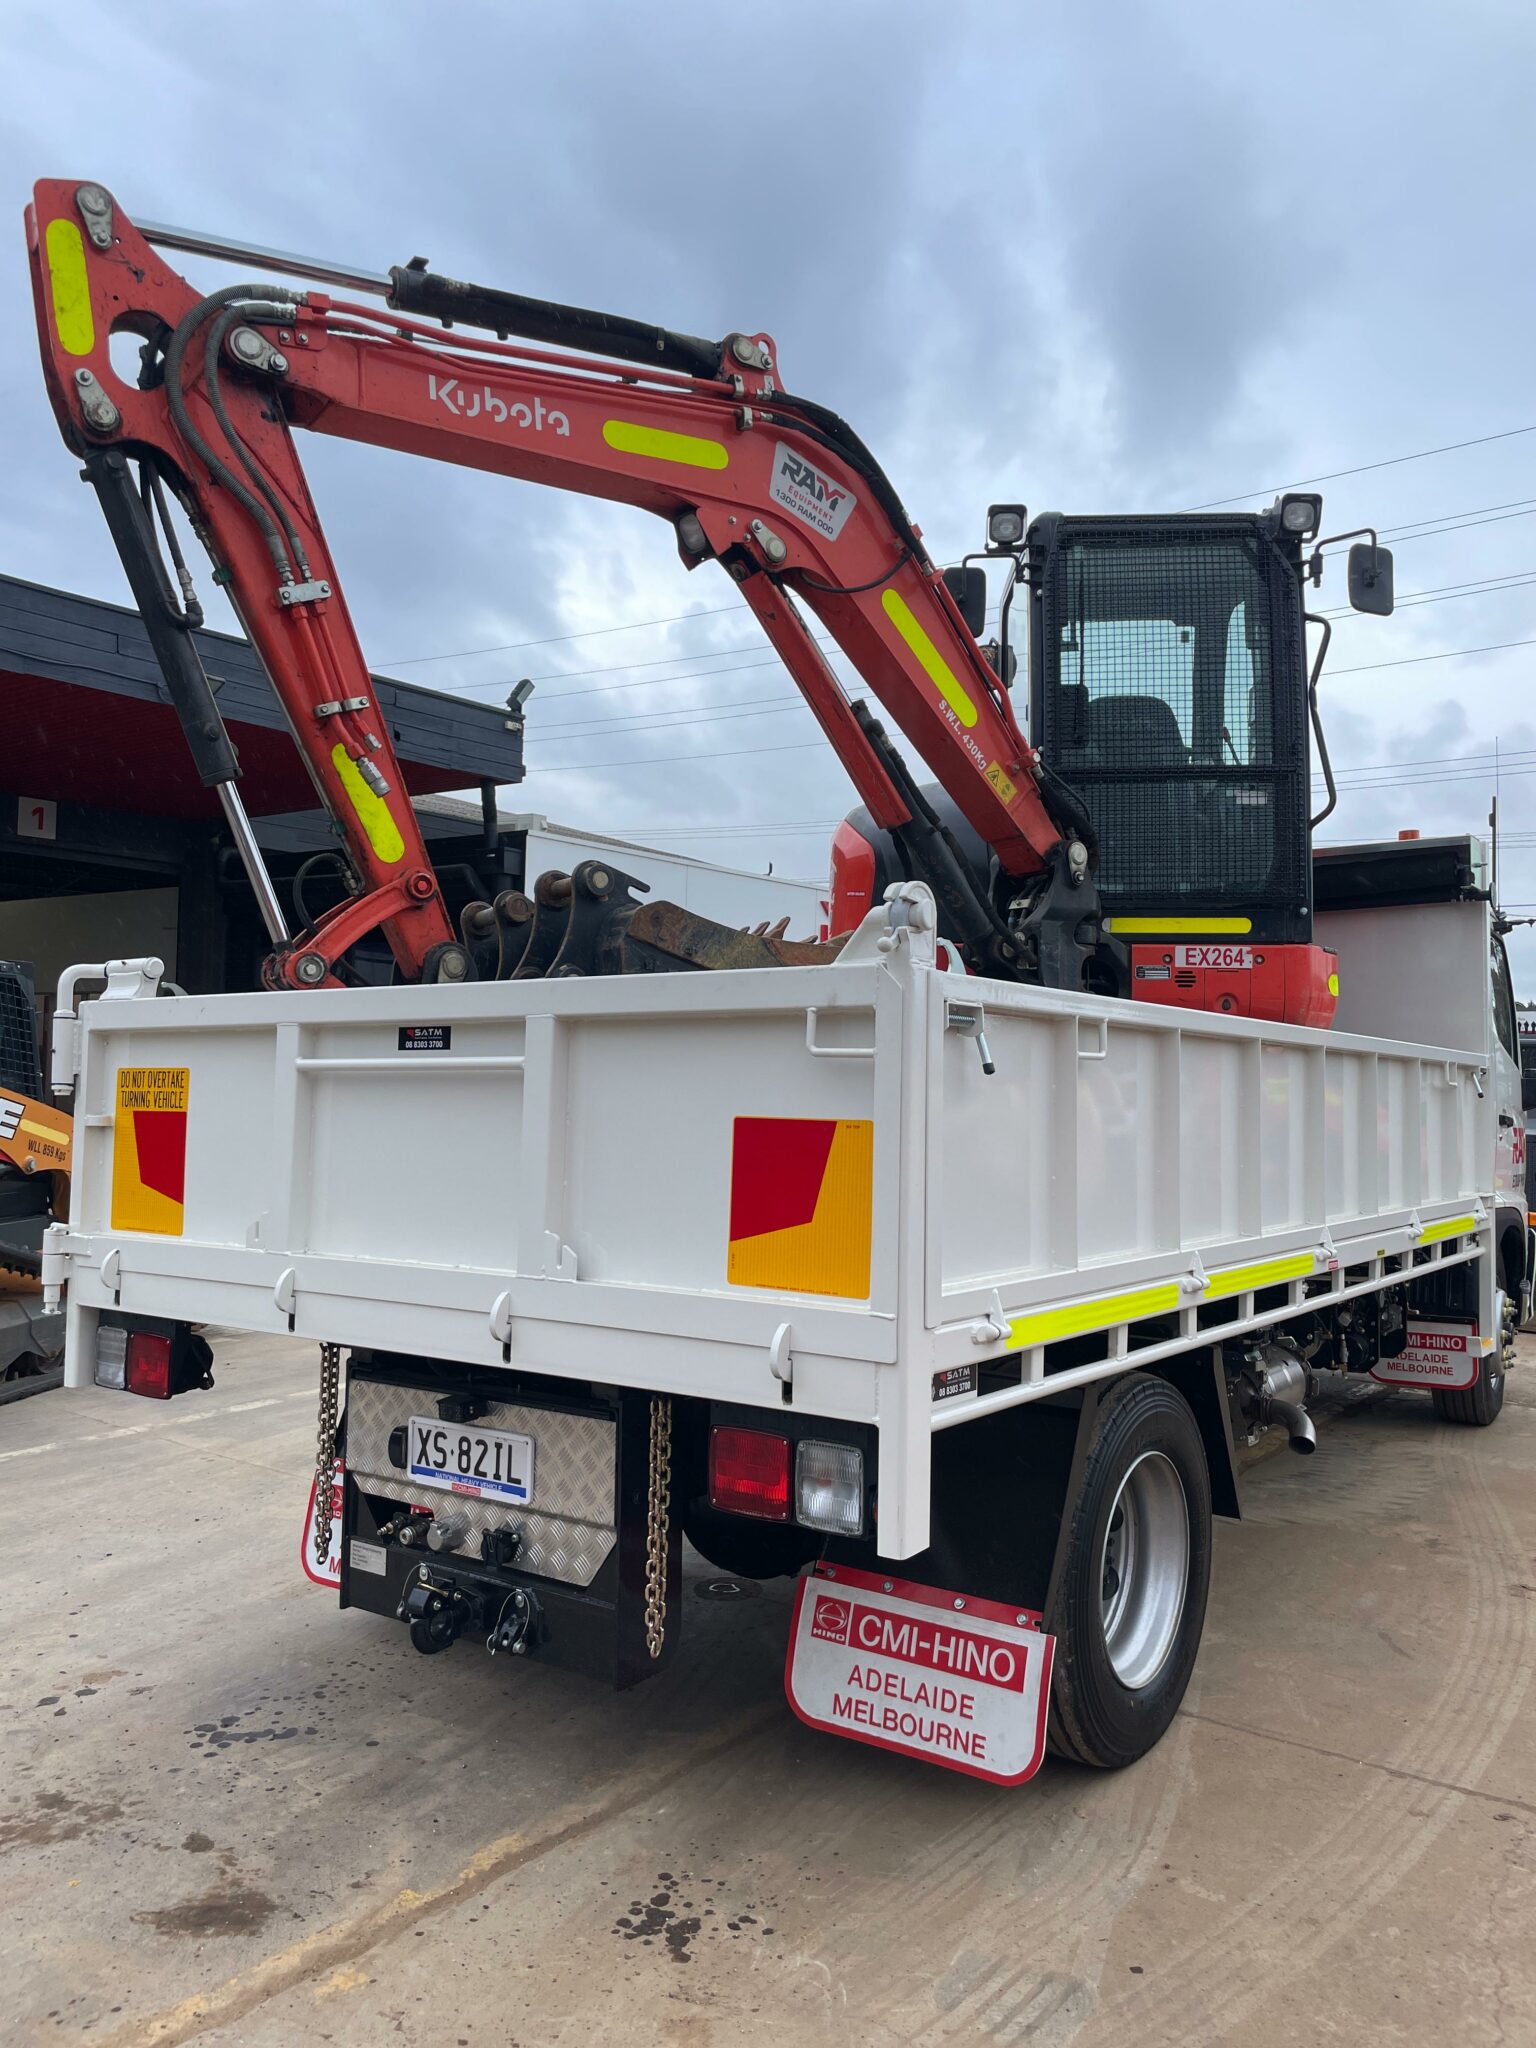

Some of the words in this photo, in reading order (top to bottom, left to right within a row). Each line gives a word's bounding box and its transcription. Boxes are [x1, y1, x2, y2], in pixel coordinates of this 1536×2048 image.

[428, 374, 570, 437] Kubota
[781, 452, 847, 512] RAM
[776, 489, 797, 509] 1300
[797, 504, 816, 522] RAM
[817, 518, 834, 535] 000
[788, 485, 833, 522] EQUIPMENT
[939, 699, 961, 735] S.W.L.
[31, 806, 44, 830] 1
[1185, 947, 1245, 967] EX264
[414, 1028, 443, 1036] SATM
[428, 1040, 443, 1048] 3700
[121, 1071, 130, 1088] DO
[132, 1071, 146, 1088] NOT
[148, 1071, 184, 1088] OVERTAKE
[121, 1090, 150, 1108] TURNING
[153, 1091, 184, 1109] VEHICLE
[28, 1139, 41, 1154] WLL
[42, 1144, 55, 1157] 859
[1407, 1334, 1462, 1350] MI-HINO
[946, 1367, 970, 1380] SATM
[1387, 1361, 1454, 1376] MELBOURNE
[435, 1471, 460, 1482] NATIONAL
[460, 1476, 480, 1487] HEAVY
[480, 1481, 503, 1491] VEHICLE
[812, 1626, 846, 1642] HINO
[858, 1613, 1016, 1682] CMI-HINO
[847, 1664, 975, 1720] ADELAIDE
[832, 1693, 987, 1760] MELBOURNE
